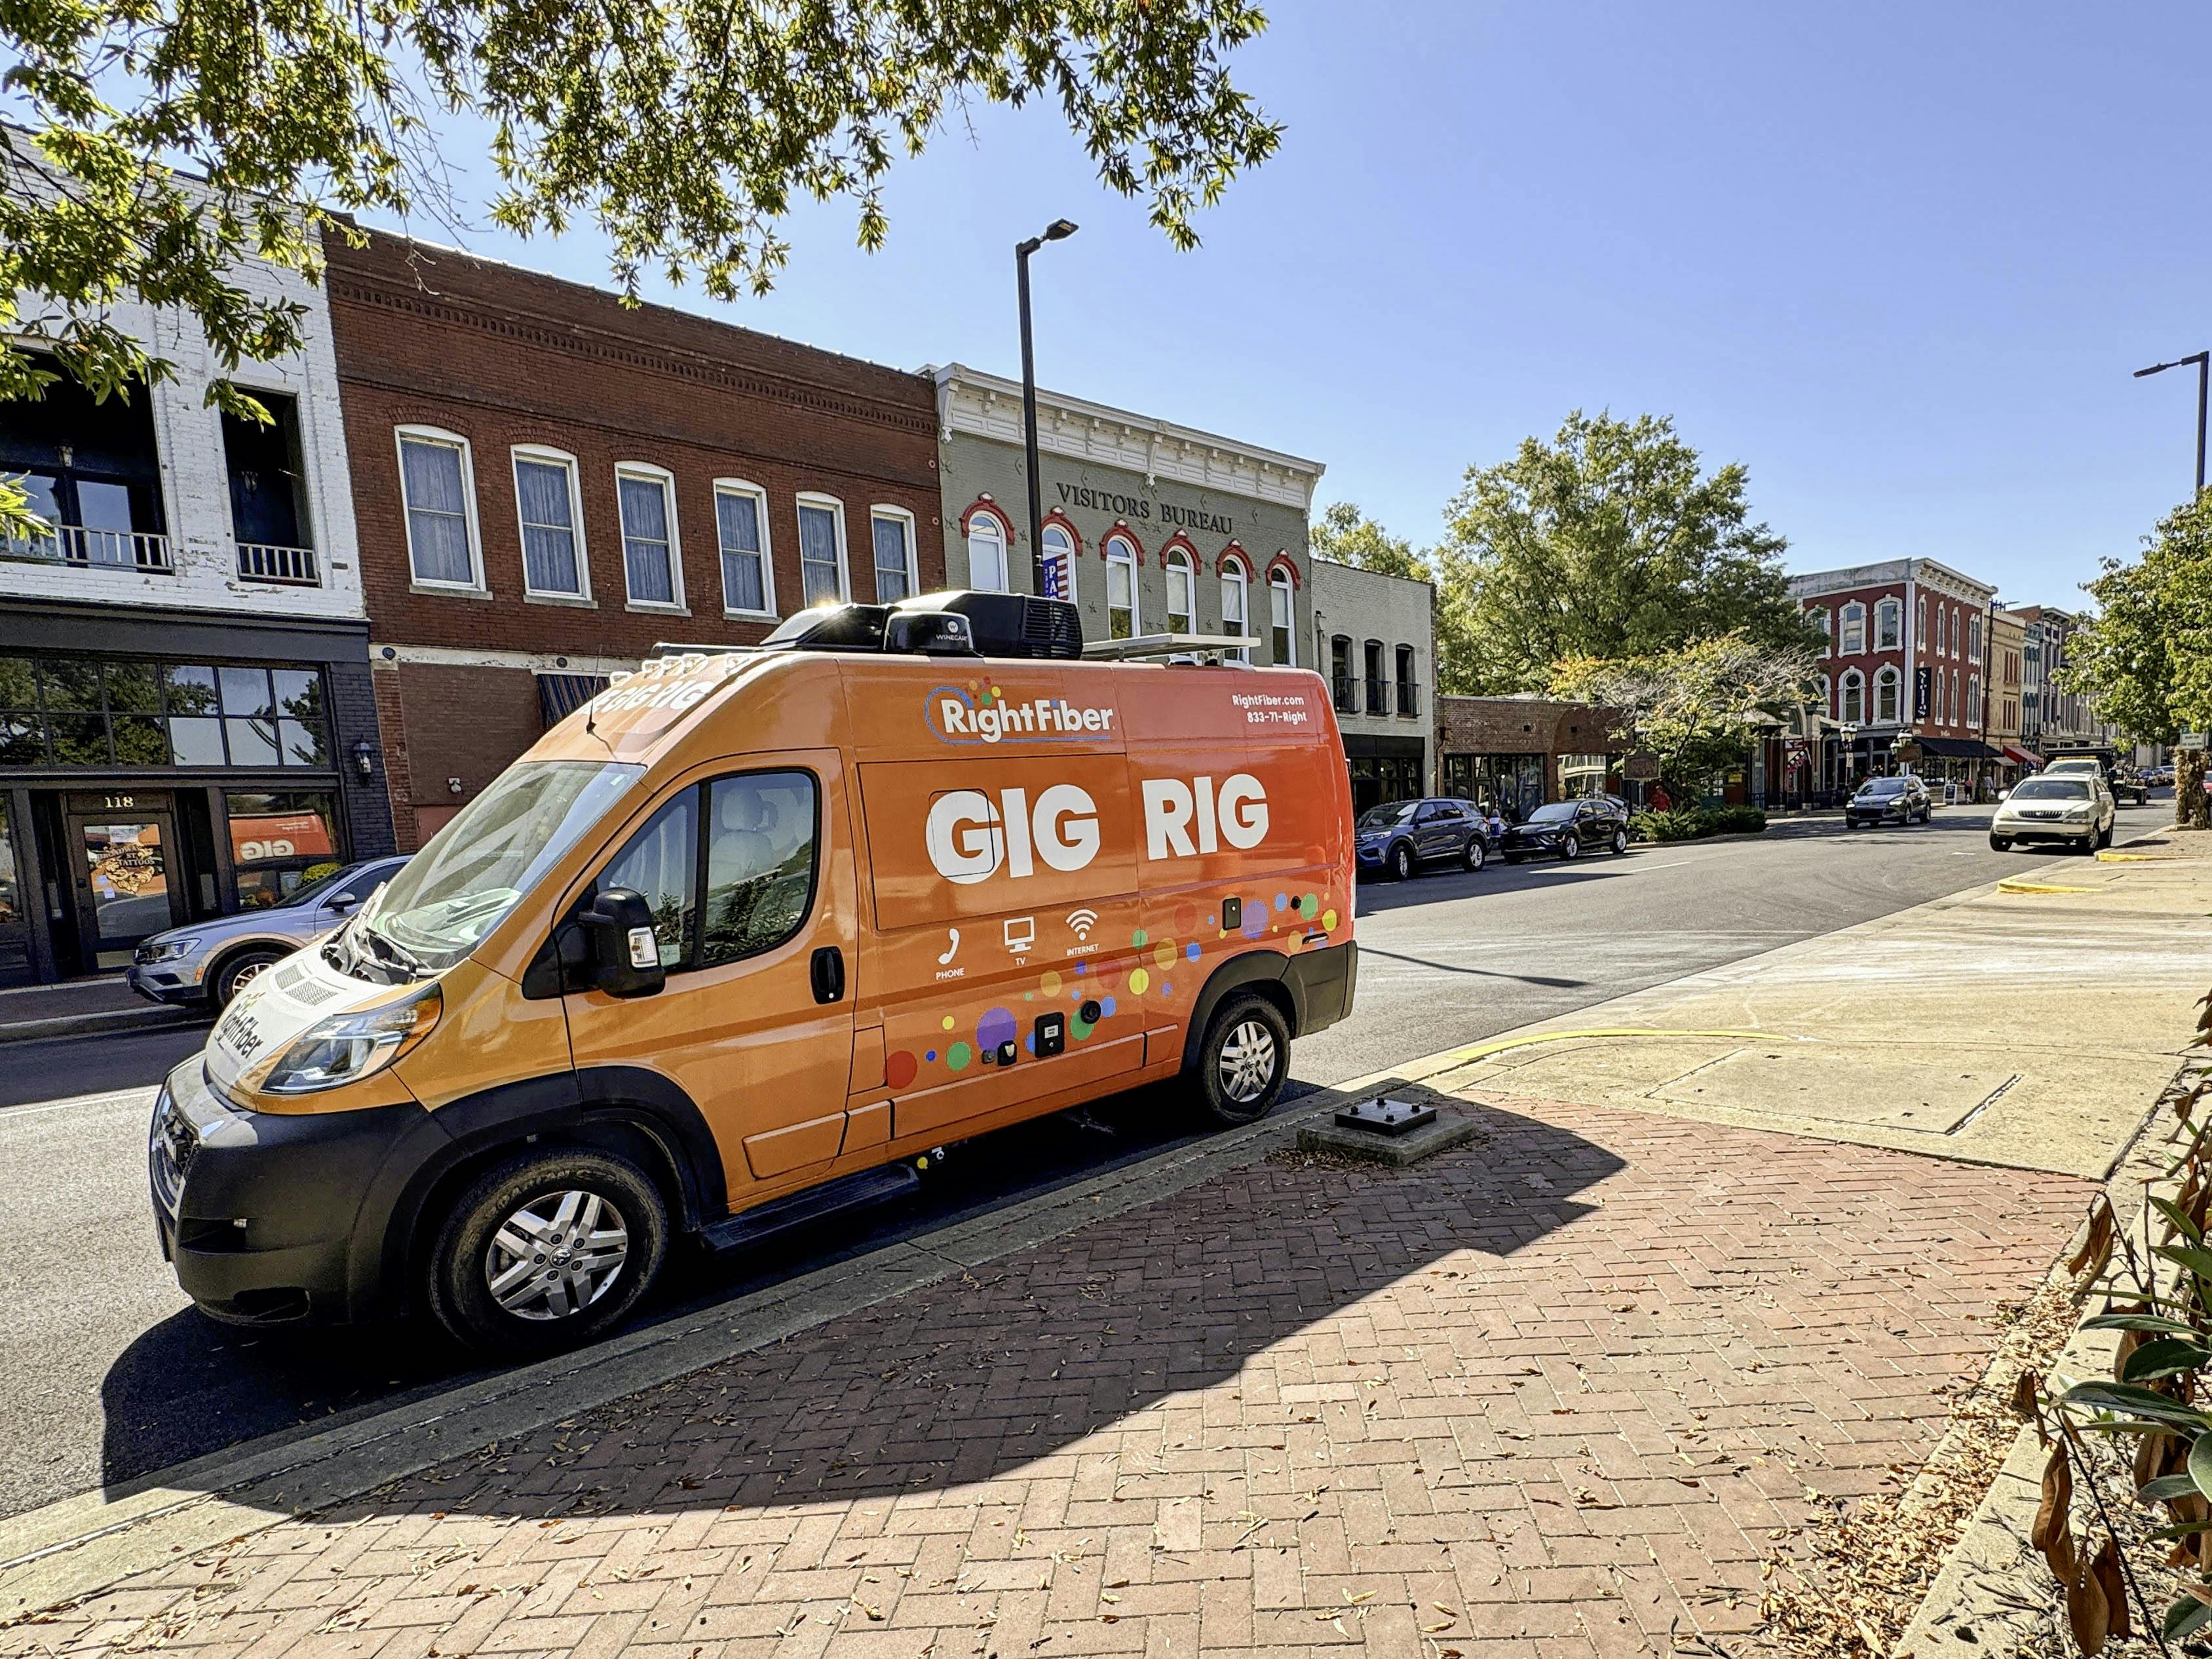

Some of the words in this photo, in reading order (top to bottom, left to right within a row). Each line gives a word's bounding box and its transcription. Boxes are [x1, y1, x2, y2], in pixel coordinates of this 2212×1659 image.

[1056, 482, 1149, 519] VISITORS
[1160, 503, 1233, 535] BUREAU
[1232, 694, 1305, 709] RightFiber.com
[940, 699, 1113, 743] RightFiber
[1247, 710, 1307, 725] 833-71-Right
[104, 796, 134, 808] 118
[925, 784, 1101, 885] GIG
[1141, 773, 1270, 860] RIG
[1067, 944, 1099, 957] INTERNET
[1016, 957, 1027, 966] TV
[936, 968, 965, 980] PHONE
